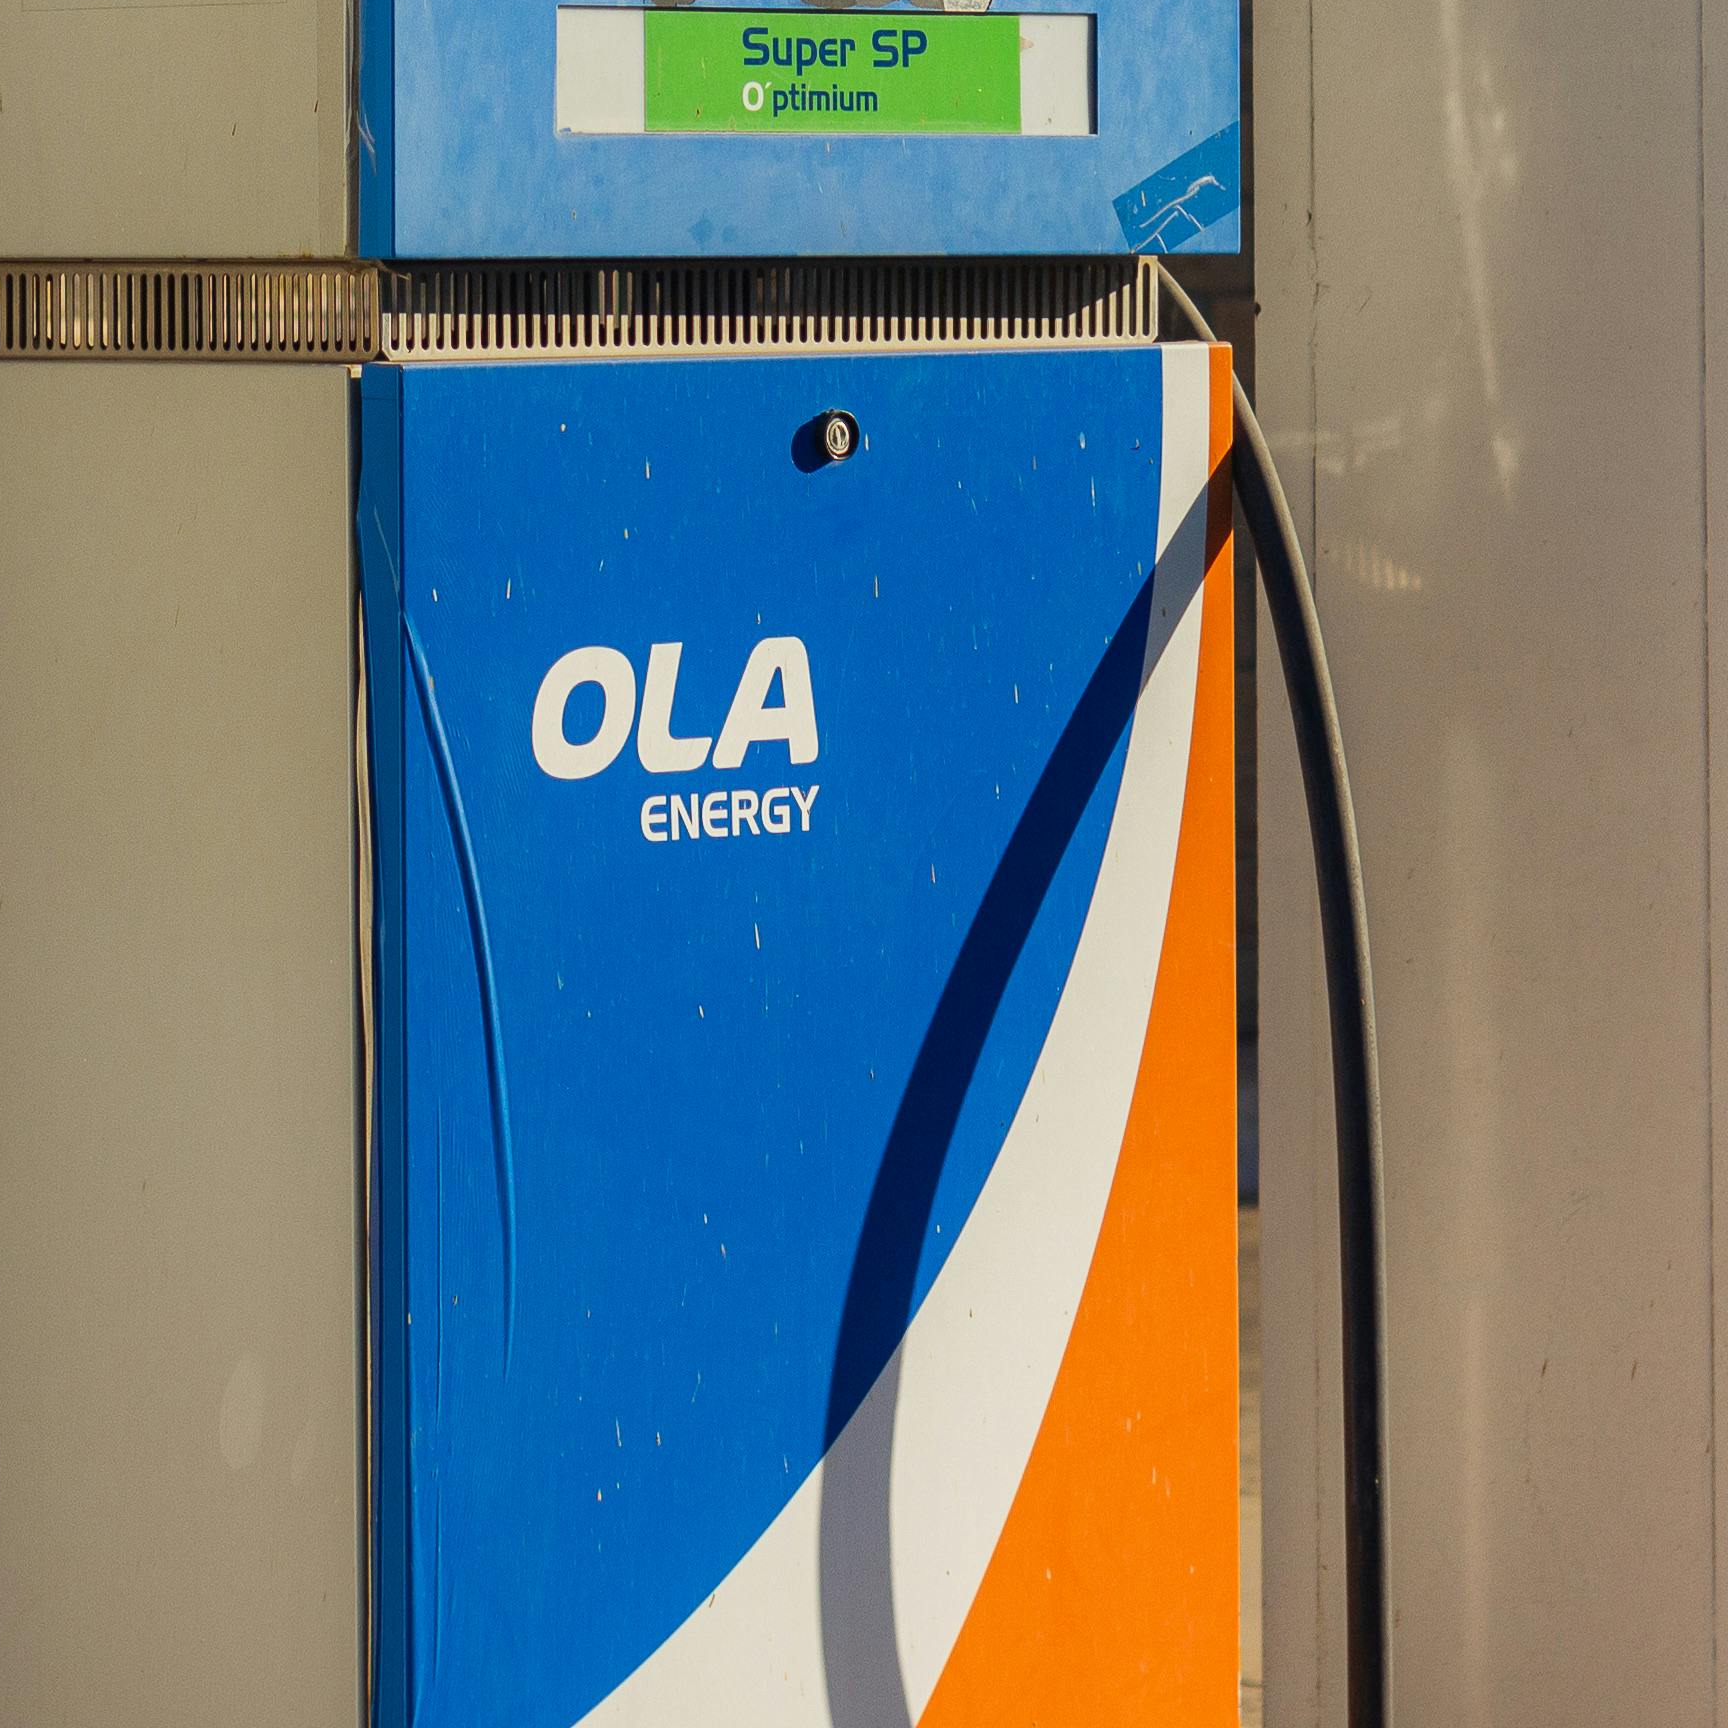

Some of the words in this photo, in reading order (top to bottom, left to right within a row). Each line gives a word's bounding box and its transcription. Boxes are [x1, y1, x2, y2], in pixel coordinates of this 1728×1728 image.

[742, 27, 856, 76] Super
[871, 29, 928, 68] SP
[531, 636, 819, 780] OLA
[640, 784, 820, 843] ENERGY
